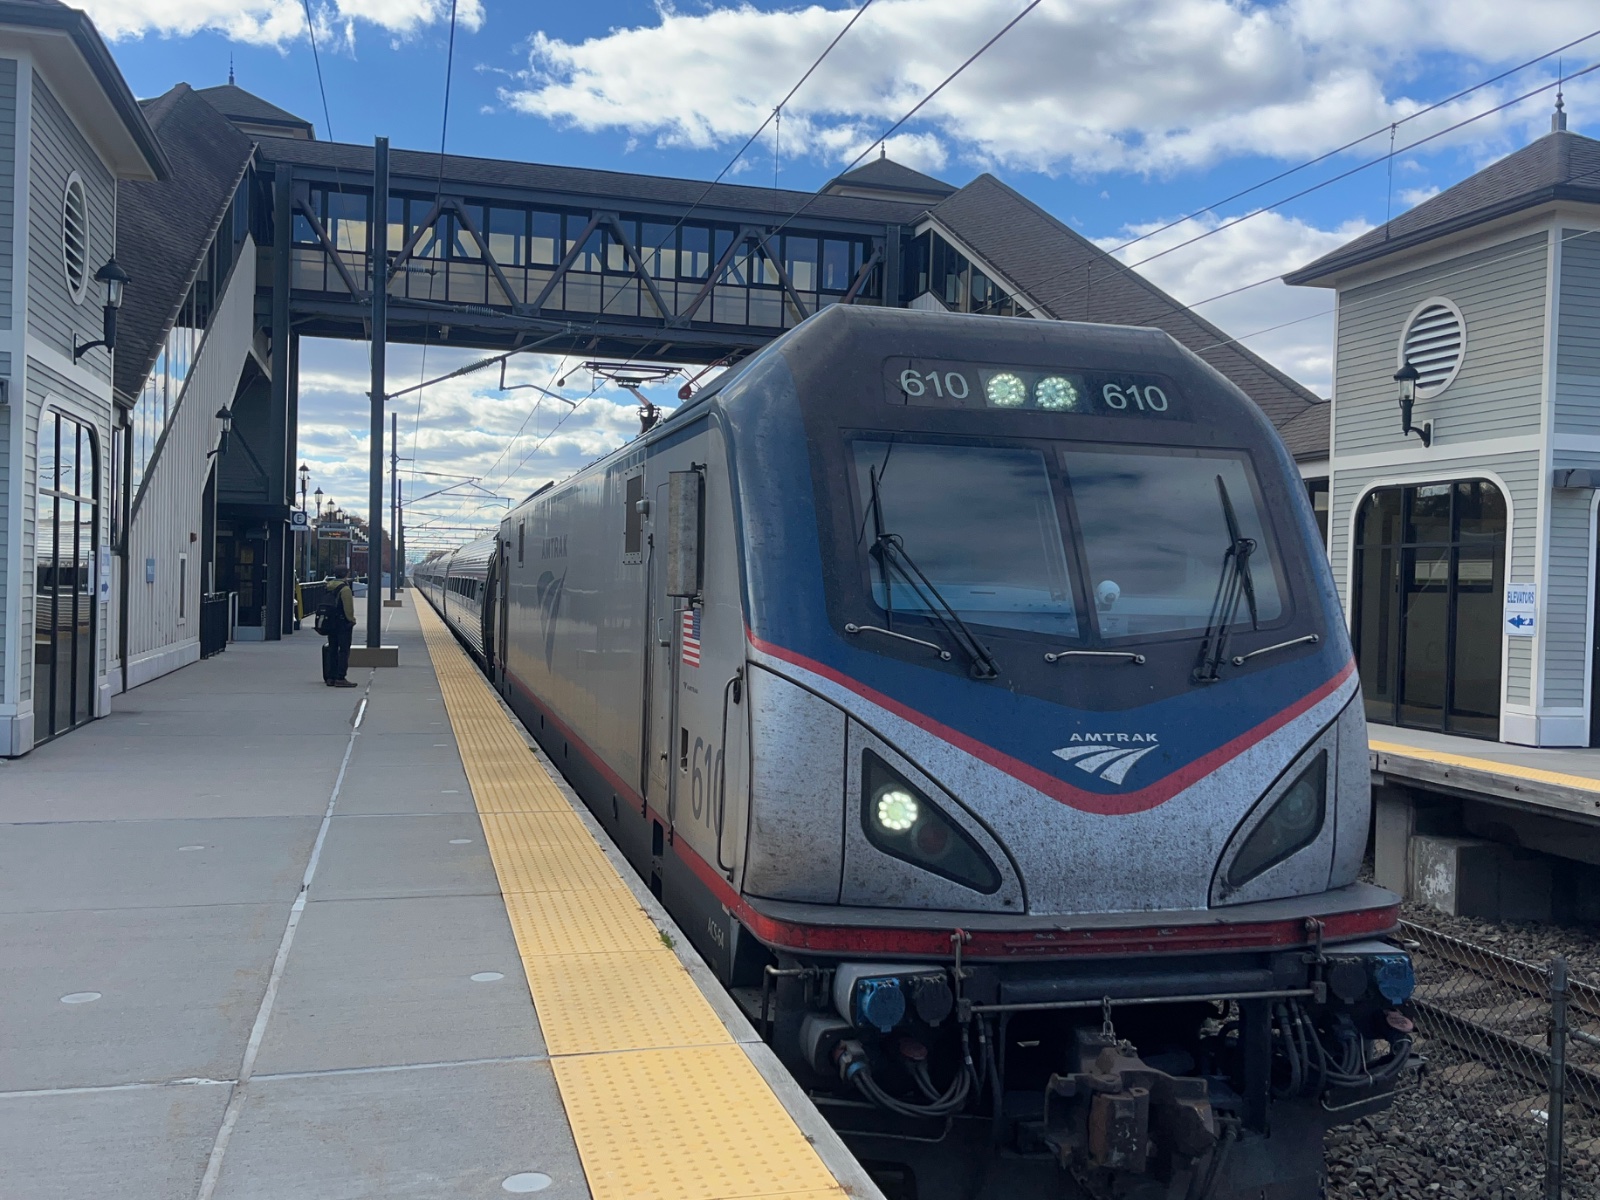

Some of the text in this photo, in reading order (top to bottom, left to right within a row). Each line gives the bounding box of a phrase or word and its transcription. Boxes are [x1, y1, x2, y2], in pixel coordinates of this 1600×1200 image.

[900, 369, 970, 400] 610
[1102, 383, 1169, 412] 610
[1507, 591, 1534, 604] ELEVATORS
[1069, 733, 1159, 742] AMTRAK
[692, 736, 727, 838] 610
